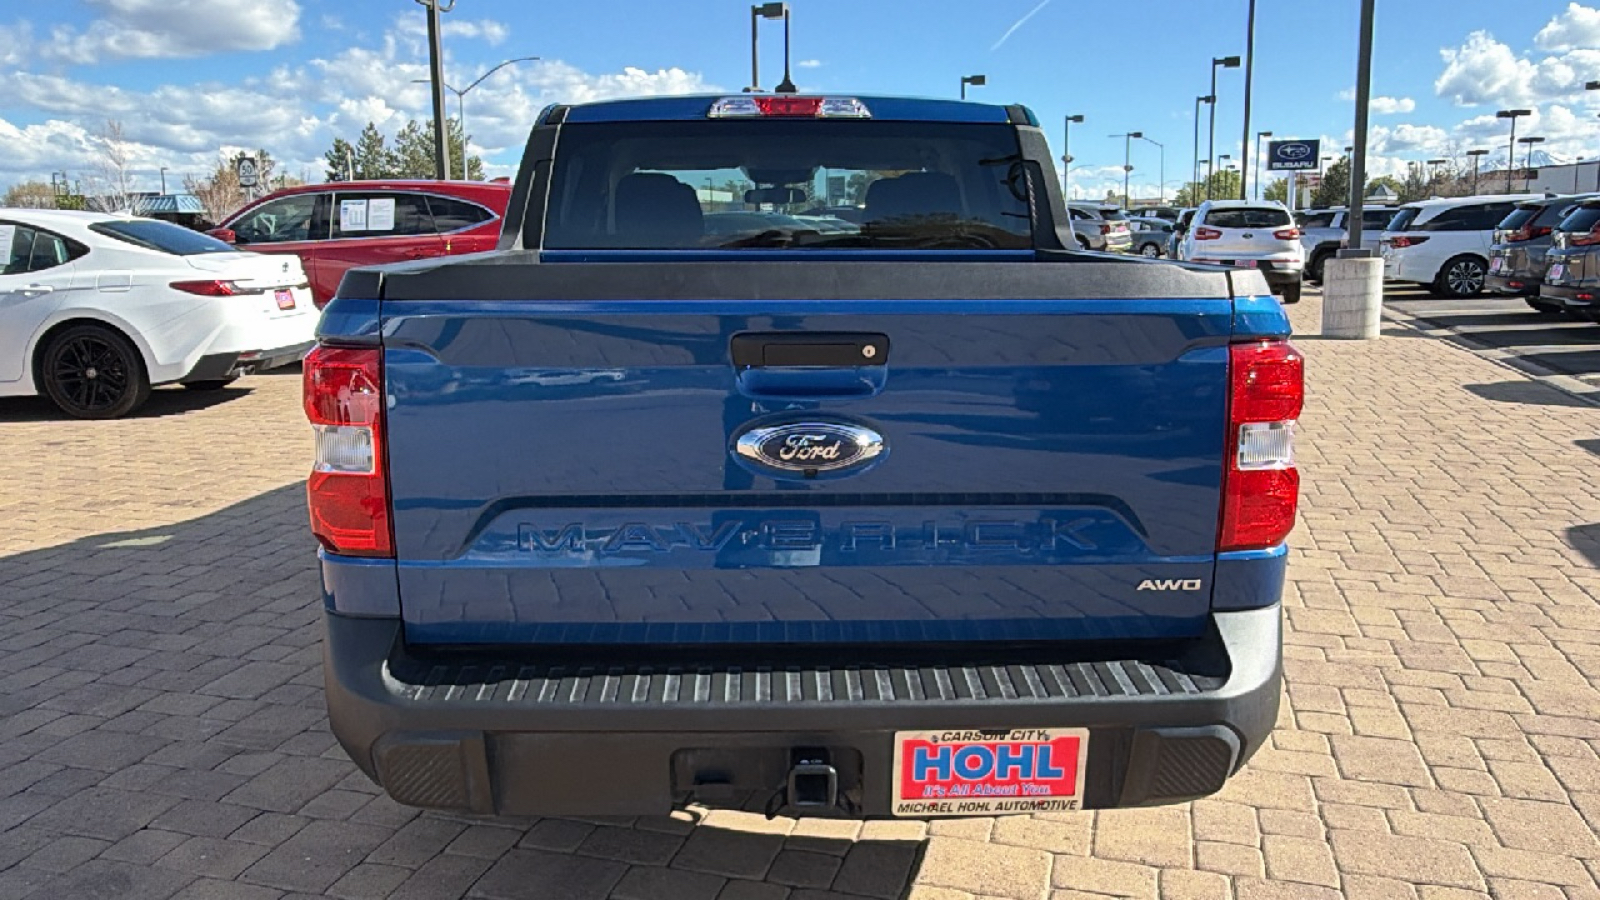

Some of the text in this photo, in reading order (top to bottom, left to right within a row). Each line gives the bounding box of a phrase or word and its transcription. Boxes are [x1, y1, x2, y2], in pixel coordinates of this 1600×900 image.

[242, 165, 252, 175] 50
[1272, 161, 1314, 169] SUBARU
[779, 434, 841, 460] Ford
[517, 520, 1098, 551] MAVERICK
[1136, 579, 1201, 591] AWD
[1010, 729, 1046, 741] CITY
[913, 744, 1064, 781] HOHL
[923, 784, 945, 796] It's
[950, 783, 970, 796] All
[973, 783, 1017, 796] About
[897, 799, 1078, 813] MICHAEL HOHL AUTOMOTIVE
